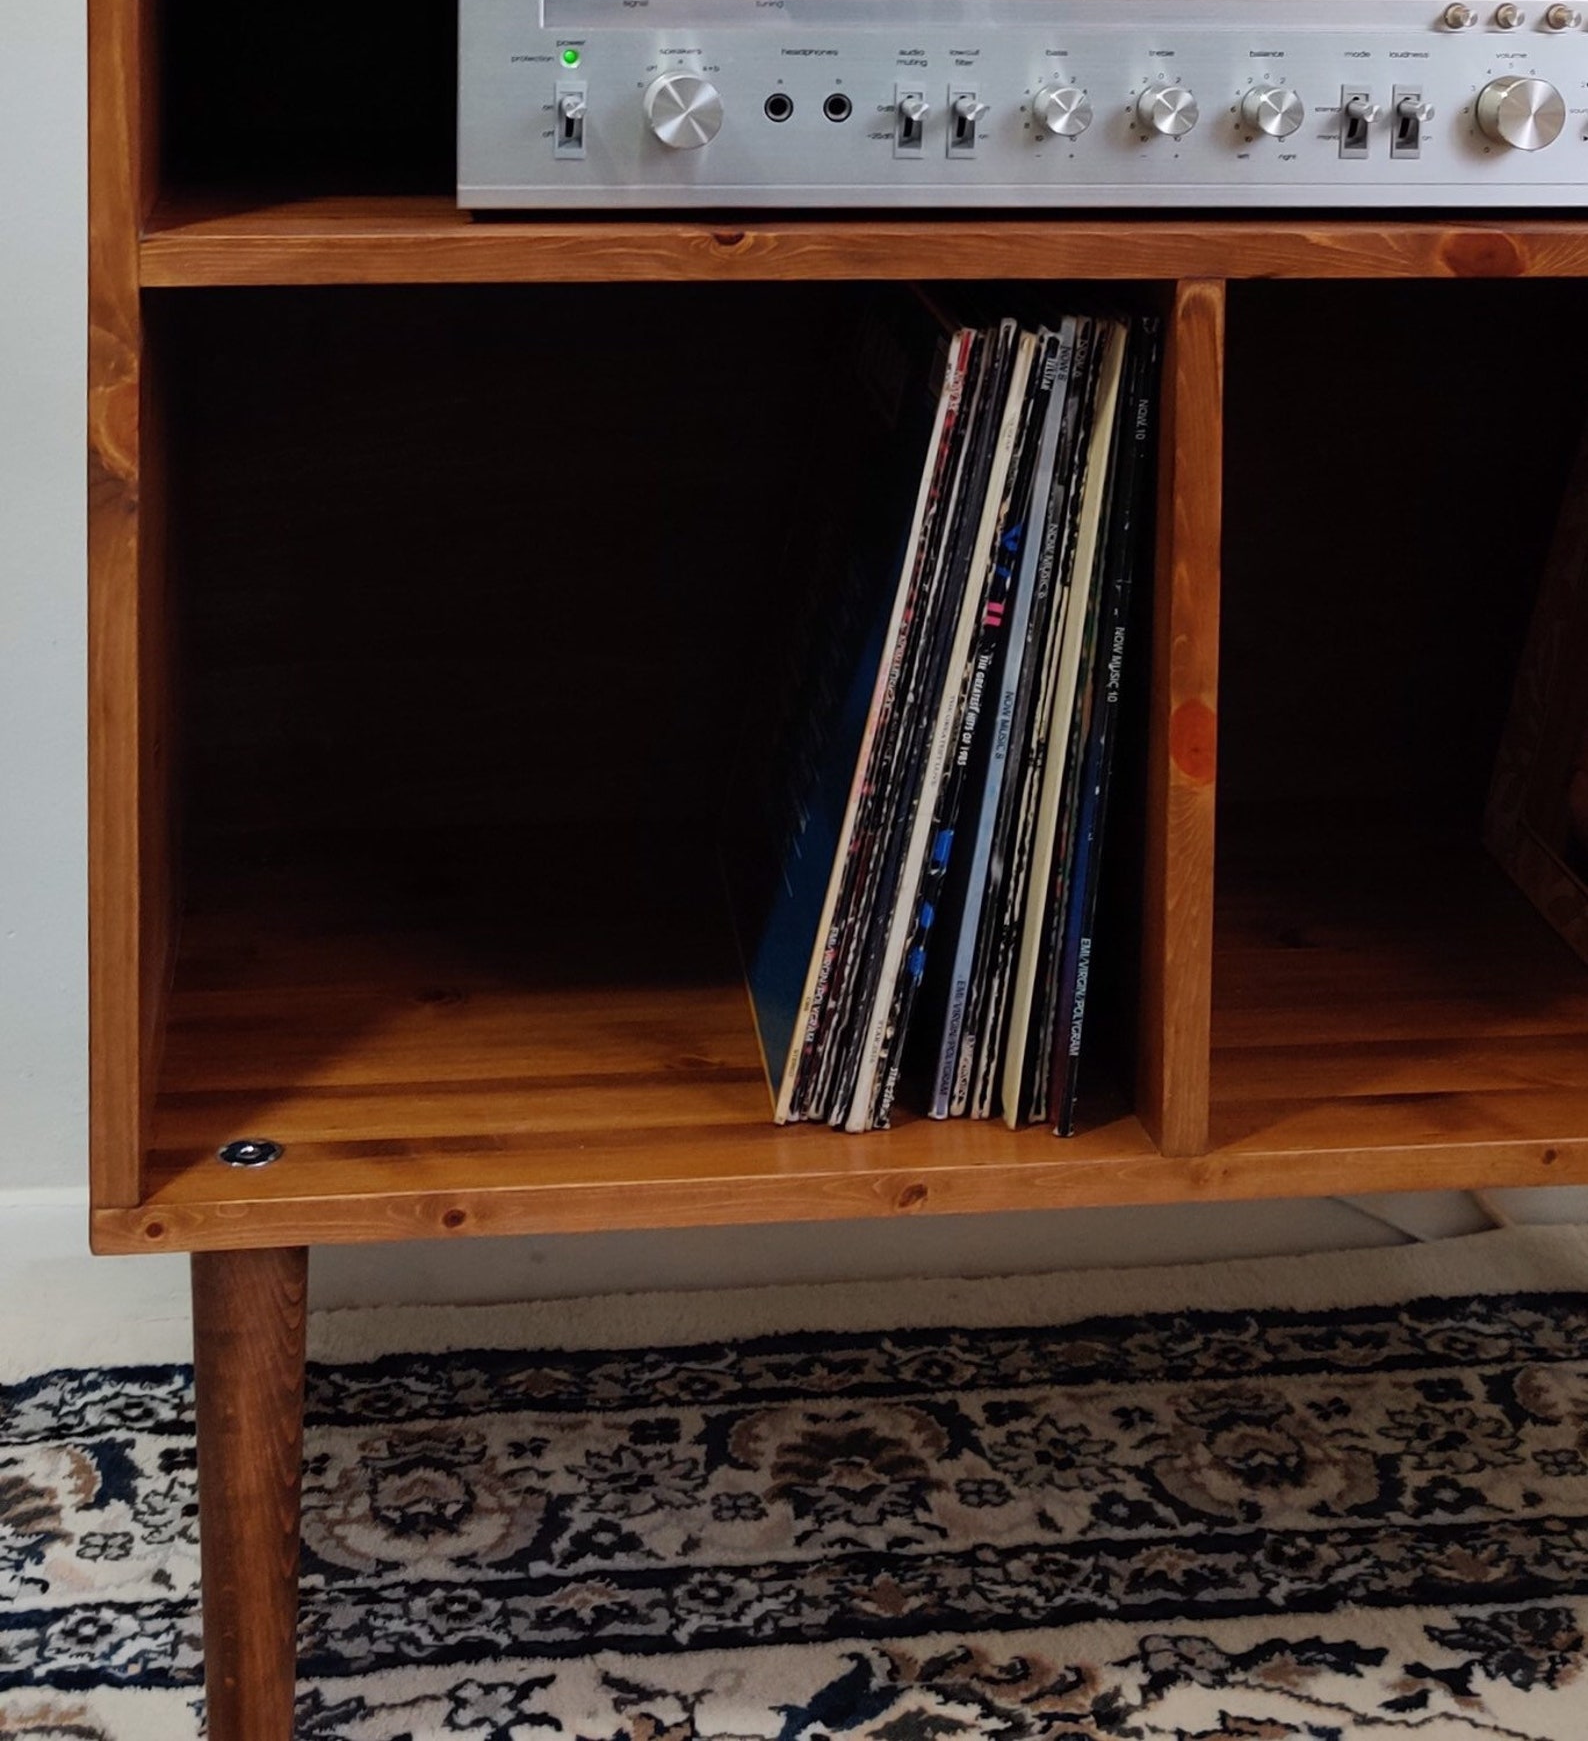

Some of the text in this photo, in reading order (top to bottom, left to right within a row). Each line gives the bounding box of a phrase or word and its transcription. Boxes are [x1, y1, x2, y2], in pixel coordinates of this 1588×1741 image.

[622, 0, 649, 8] signal
[755, 0, 785, 9] tuning
[556, 39, 586, 47] power
[659, 48, 702, 56] speakers
[781, 48, 839, 57] headphones
[899, 48, 925, 56] audio
[1046, 49, 1068, 57] bass
[1148, 49, 1175, 58] treble
[1249, 50, 1284, 58] balance
[1344, 50, 1371, 59] mode
[1389, 50, 1430, 59] loudness
[1496, 51, 1528, 59] volume
[511, 54, 555, 63] protection
[896, 58, 928, 68] muting
[954, 58, 975, 67] filter
[1059, 344, 1071, 372] NOW
[1135, 430, 1147, 441] 10
[1046, 522, 1059, 553] NOW
[1039, 555, 1054, 589] MUSIC
[1106, 626, 1126, 703] NOW MUSIC 10
[967, 670, 987, 712] GREATEST
[999, 690, 1014, 720] NOW
[963, 711, 977, 731] HITS
[997, 721, 1010, 751] MUSIC
[1069, 937, 1092, 1057] EMI/VIRGIN/POLYGRAM
